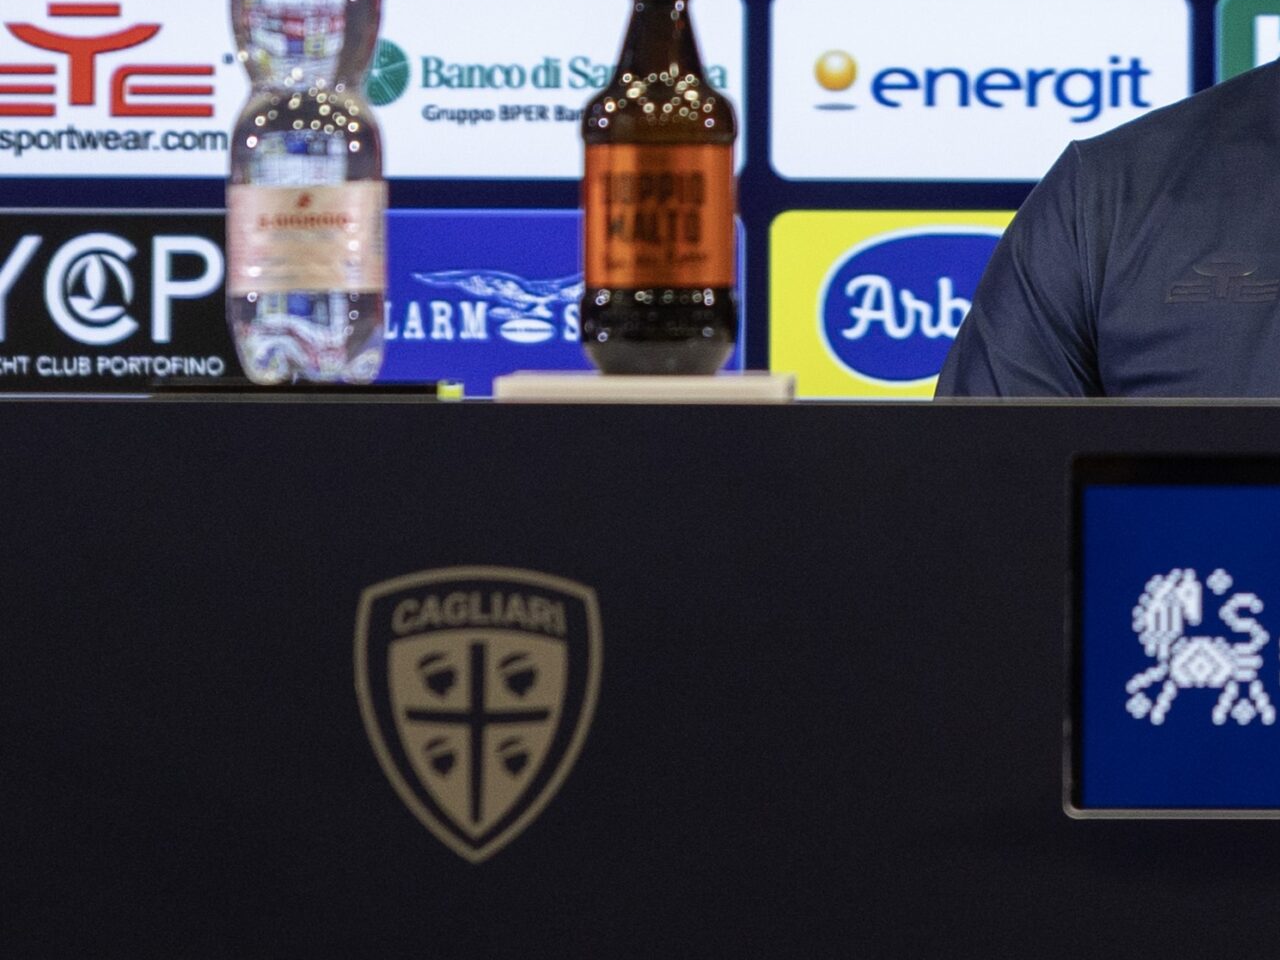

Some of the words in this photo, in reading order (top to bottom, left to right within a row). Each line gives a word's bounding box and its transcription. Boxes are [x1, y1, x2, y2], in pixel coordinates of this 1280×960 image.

[421, 55, 526, 89] Banco
[530, 55, 561, 89] di
[871, 55, 1153, 124] energit
[422, 105, 496, 124] Gruppo
[499, 105, 550, 122] BPER
[383, 301, 488, 341] LARM
[36, 354, 92, 377] CLUB
[97, 354, 225, 377] PORTOFINO
[391, 591, 568, 638] CAGLIARI
